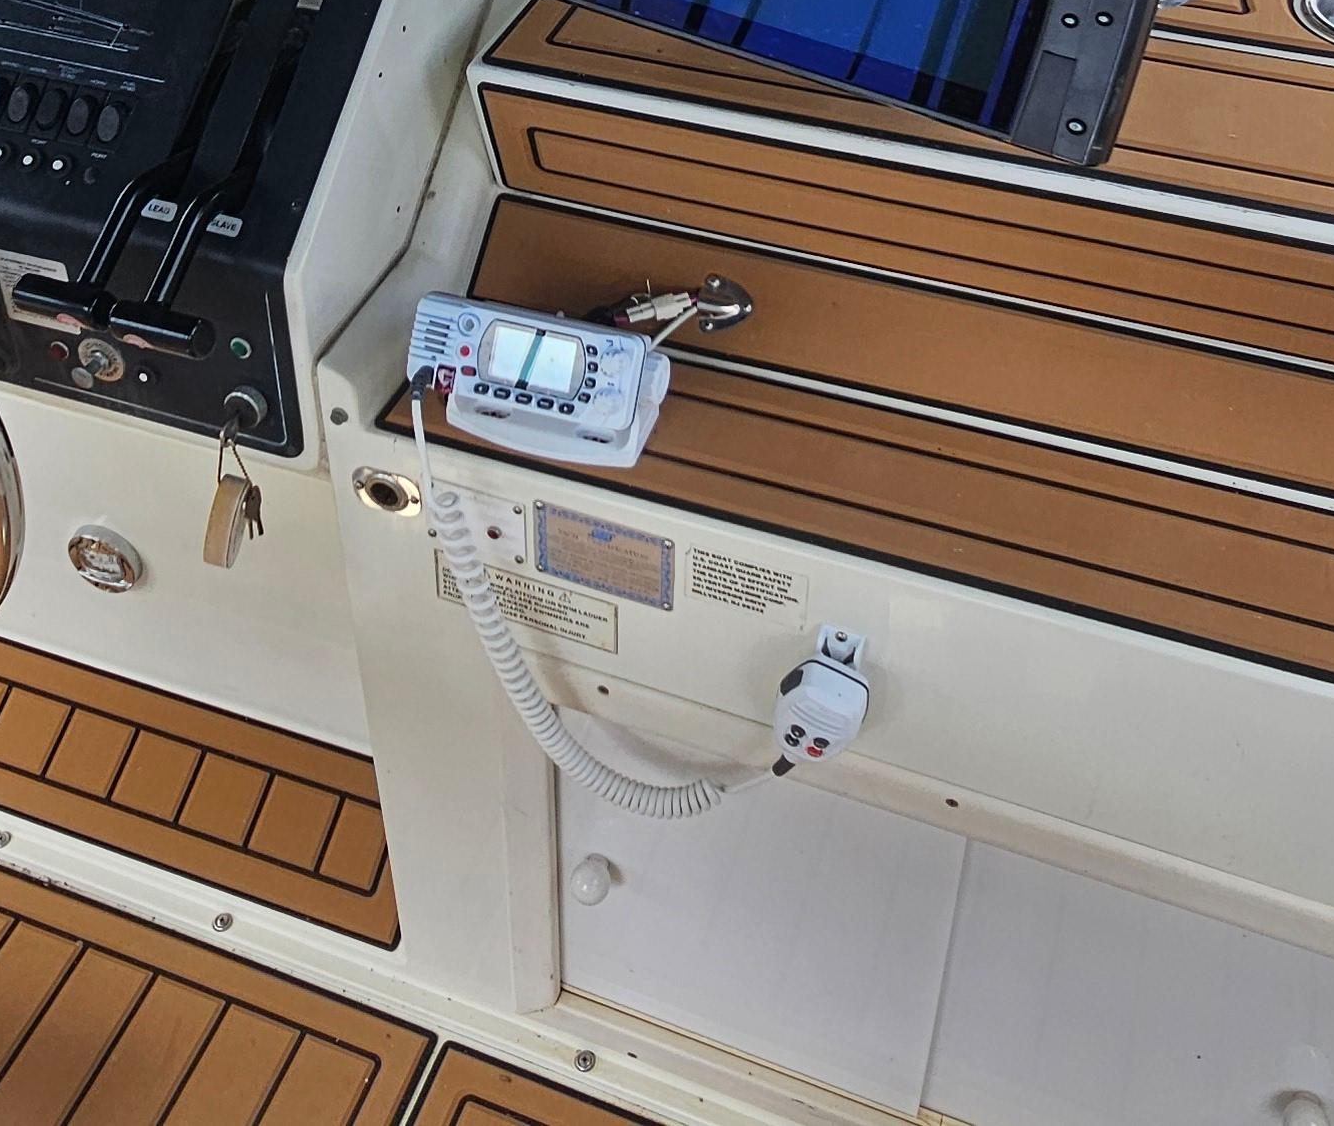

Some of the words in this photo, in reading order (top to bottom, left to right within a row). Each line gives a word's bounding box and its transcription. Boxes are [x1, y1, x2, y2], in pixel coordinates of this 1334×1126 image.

[148, 203, 170, 215] LEAD
[772, 570, 793, 581] WITH
[495, 573, 555, 597] WARNING
